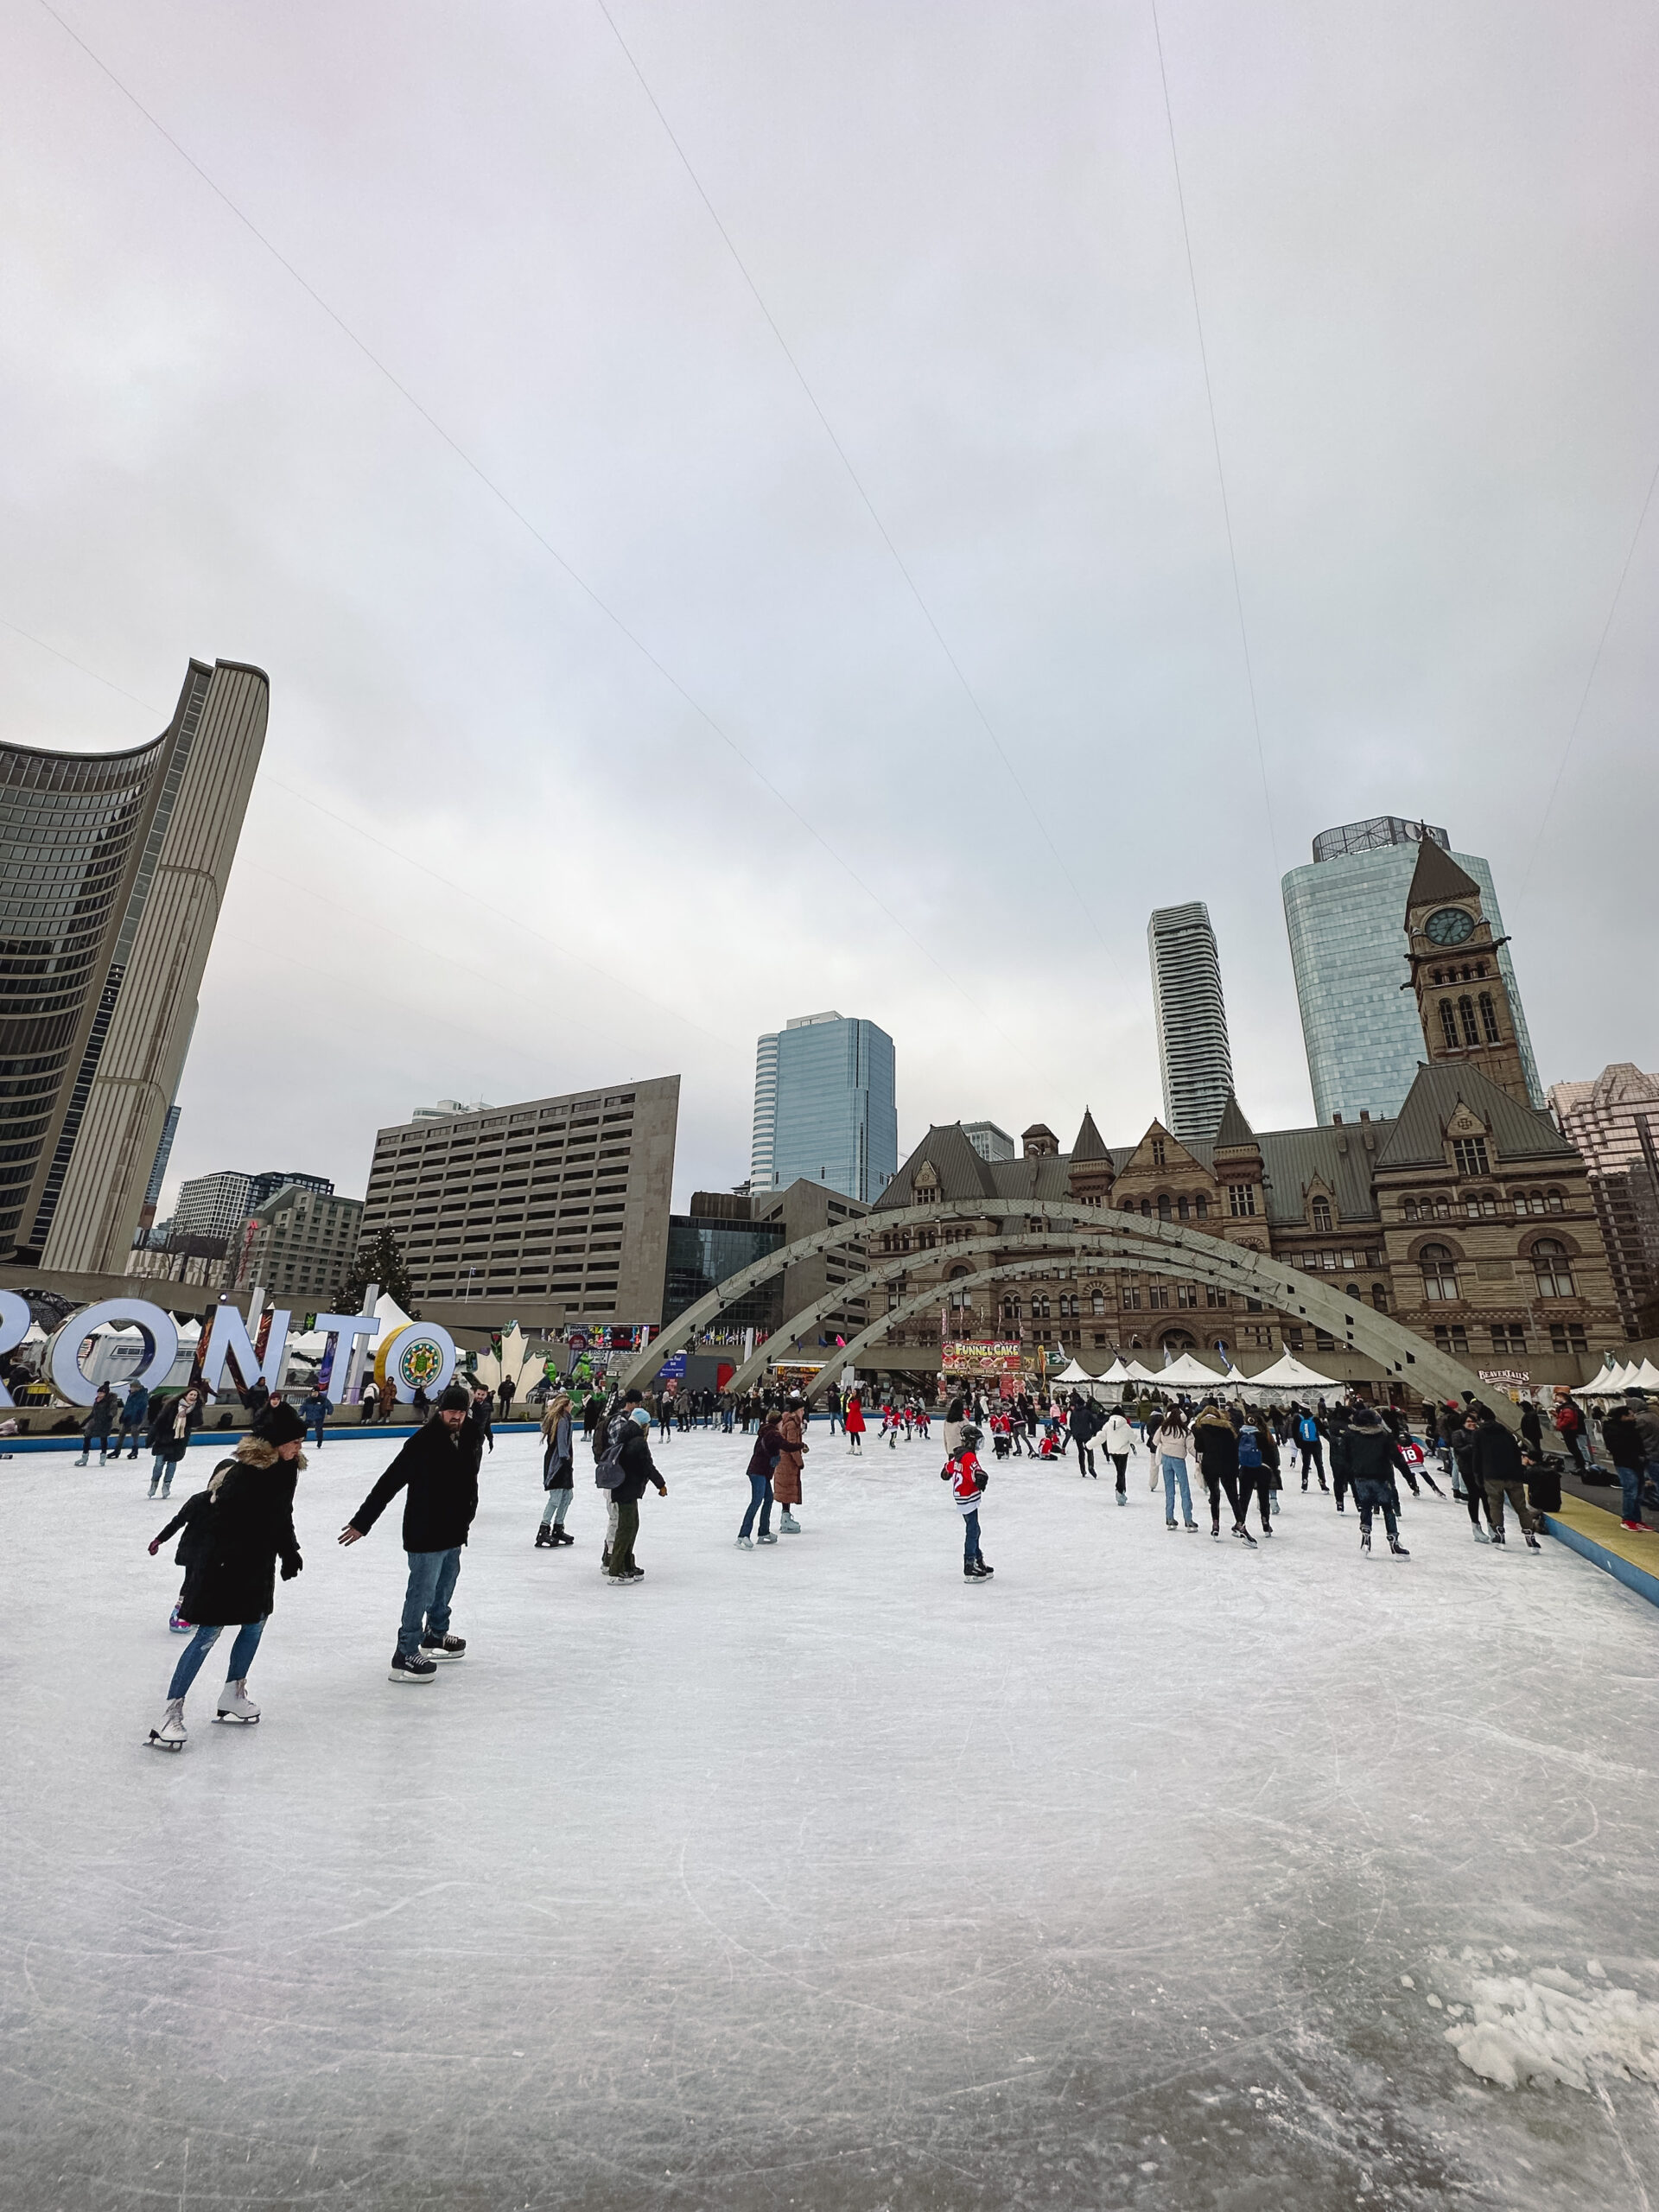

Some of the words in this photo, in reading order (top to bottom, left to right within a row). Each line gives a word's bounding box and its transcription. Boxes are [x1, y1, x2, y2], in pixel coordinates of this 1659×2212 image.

[955, 1343, 992, 1356] FUNNEL
[993, 1344, 1019, 1356] CAKE
[1402, 1449, 1417, 1462] 18
